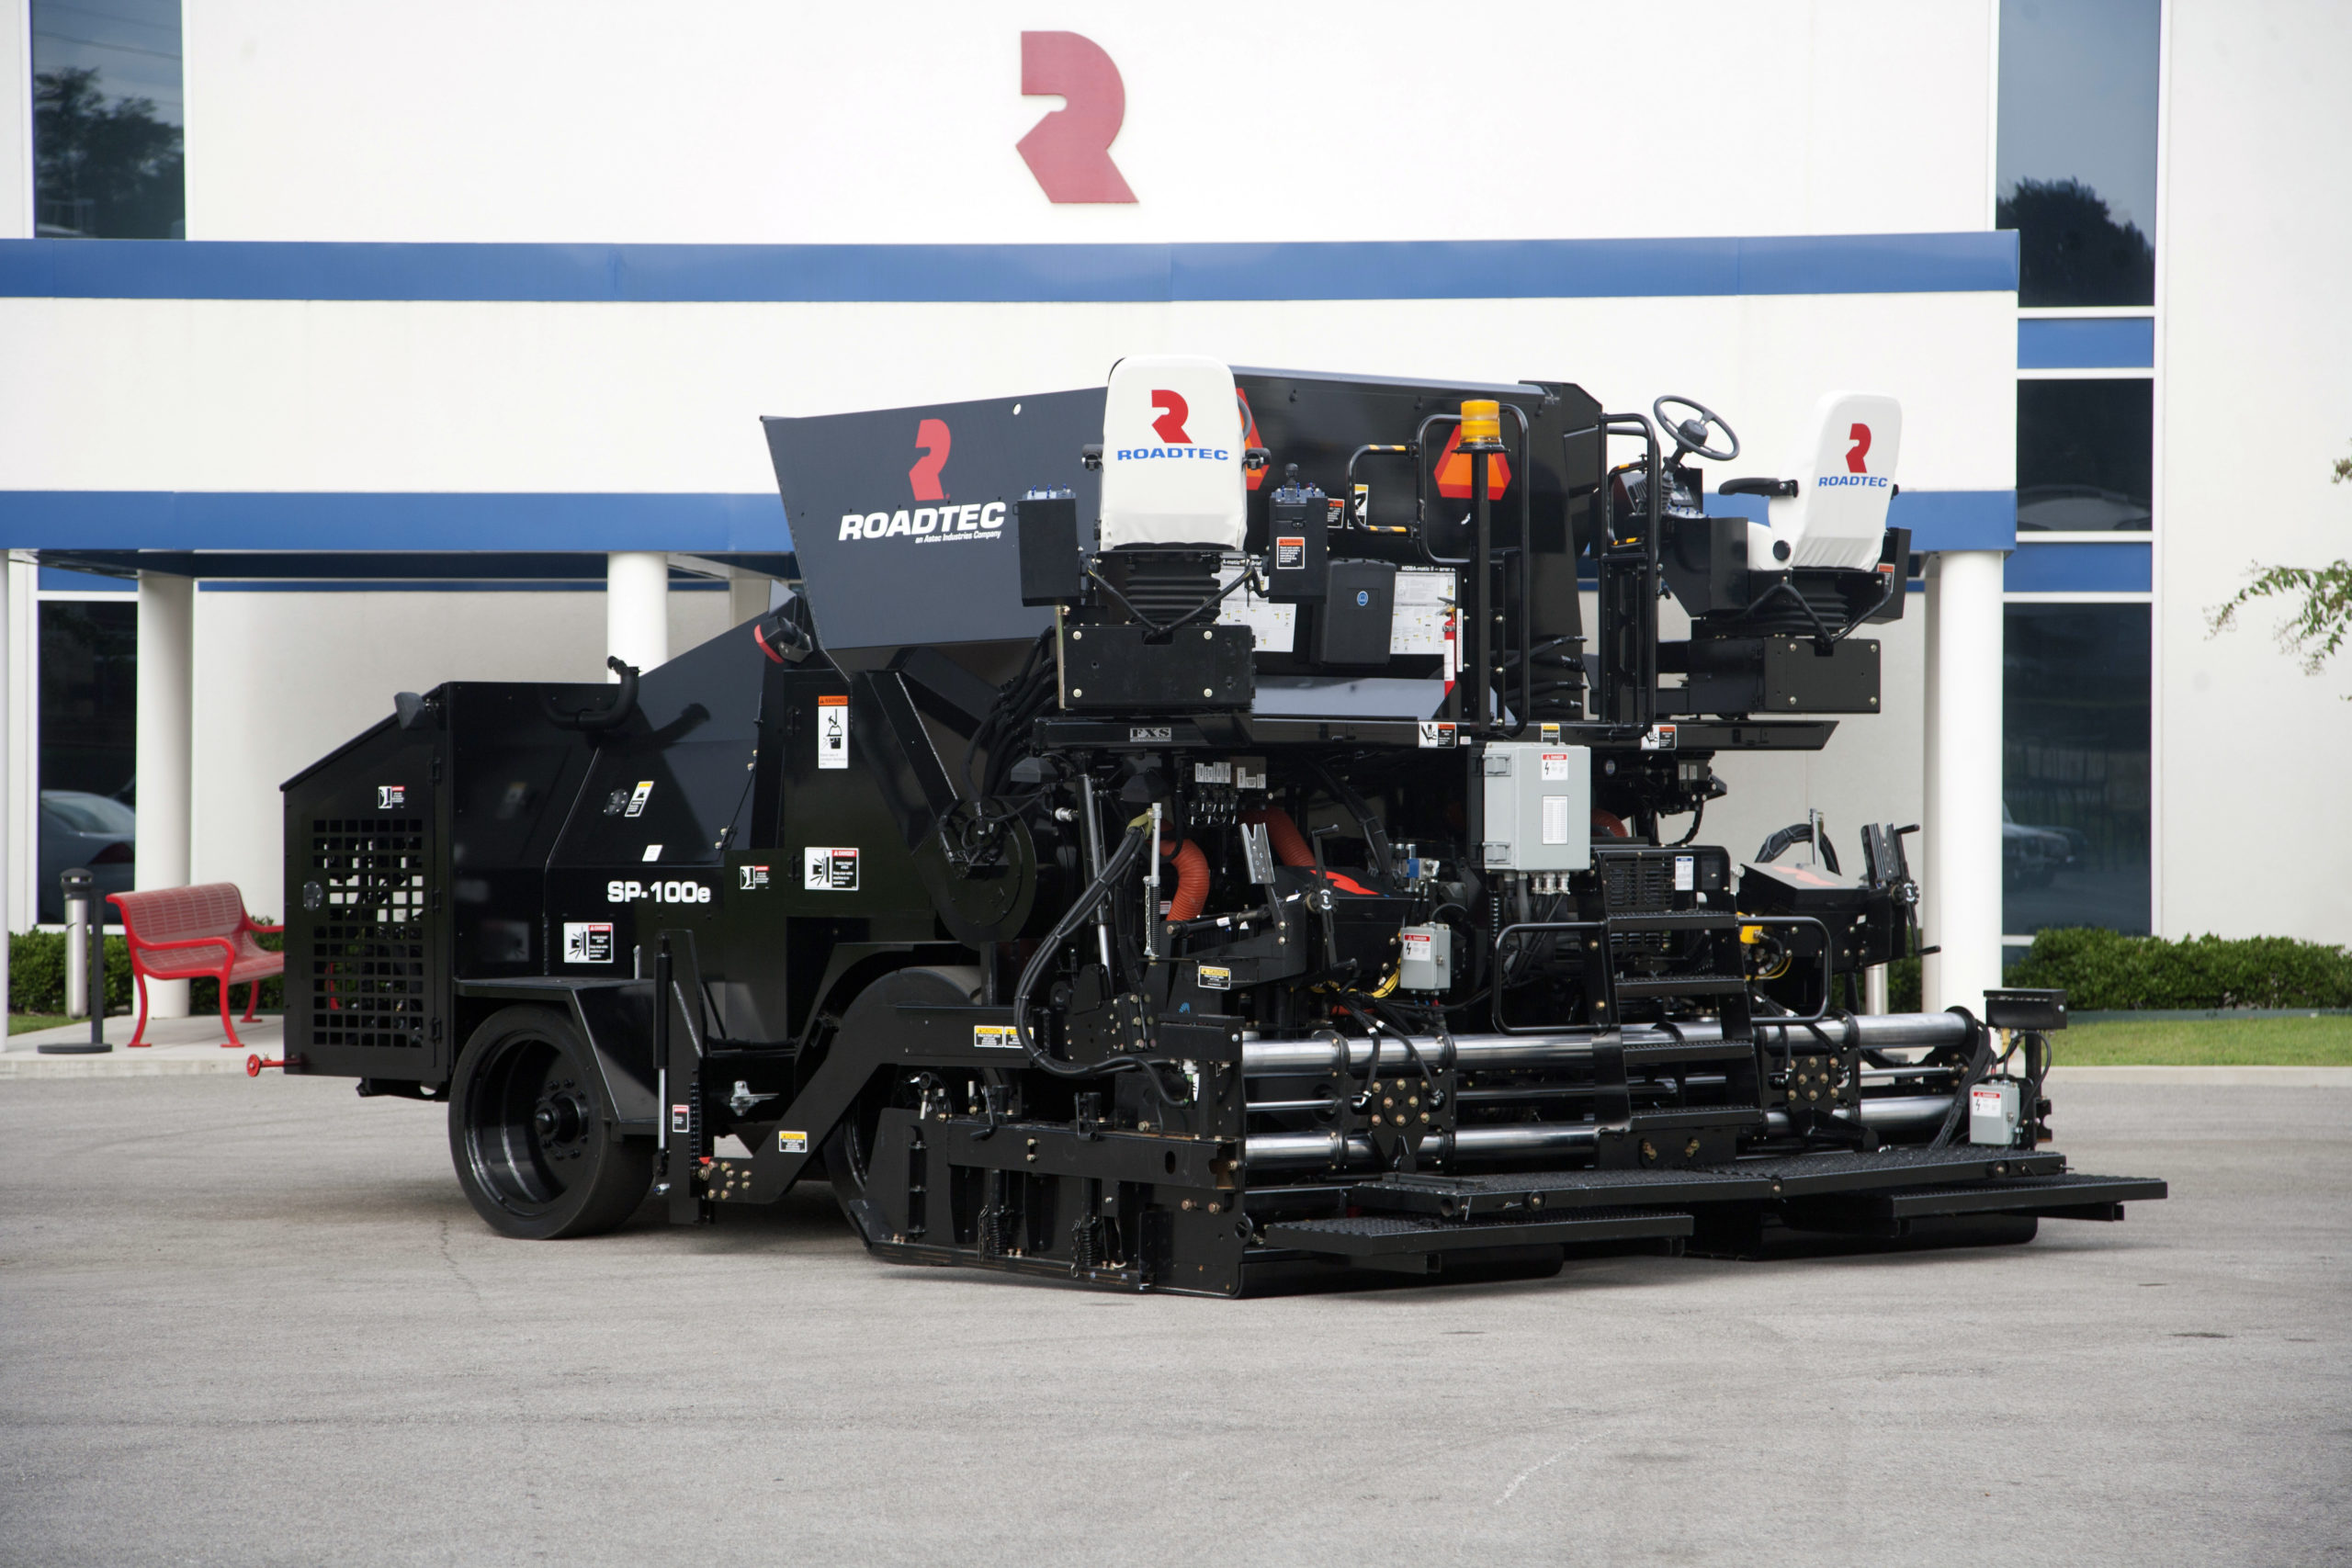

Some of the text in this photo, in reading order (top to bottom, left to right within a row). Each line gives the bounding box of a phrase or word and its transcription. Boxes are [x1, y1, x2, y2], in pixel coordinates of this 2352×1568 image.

[1117, 447, 1228, 460] ROADTEC
[1818, 476, 1888, 488] ROADTEC
[838, 502, 1007, 541] ROADTEC
[923, 535, 942, 543] Astec
[943, 533, 972, 541] Industries
[973, 530, 1001, 539] Company
[1132, 728, 1170, 738] FXS
[607, 881, 711, 903] SP-100e
